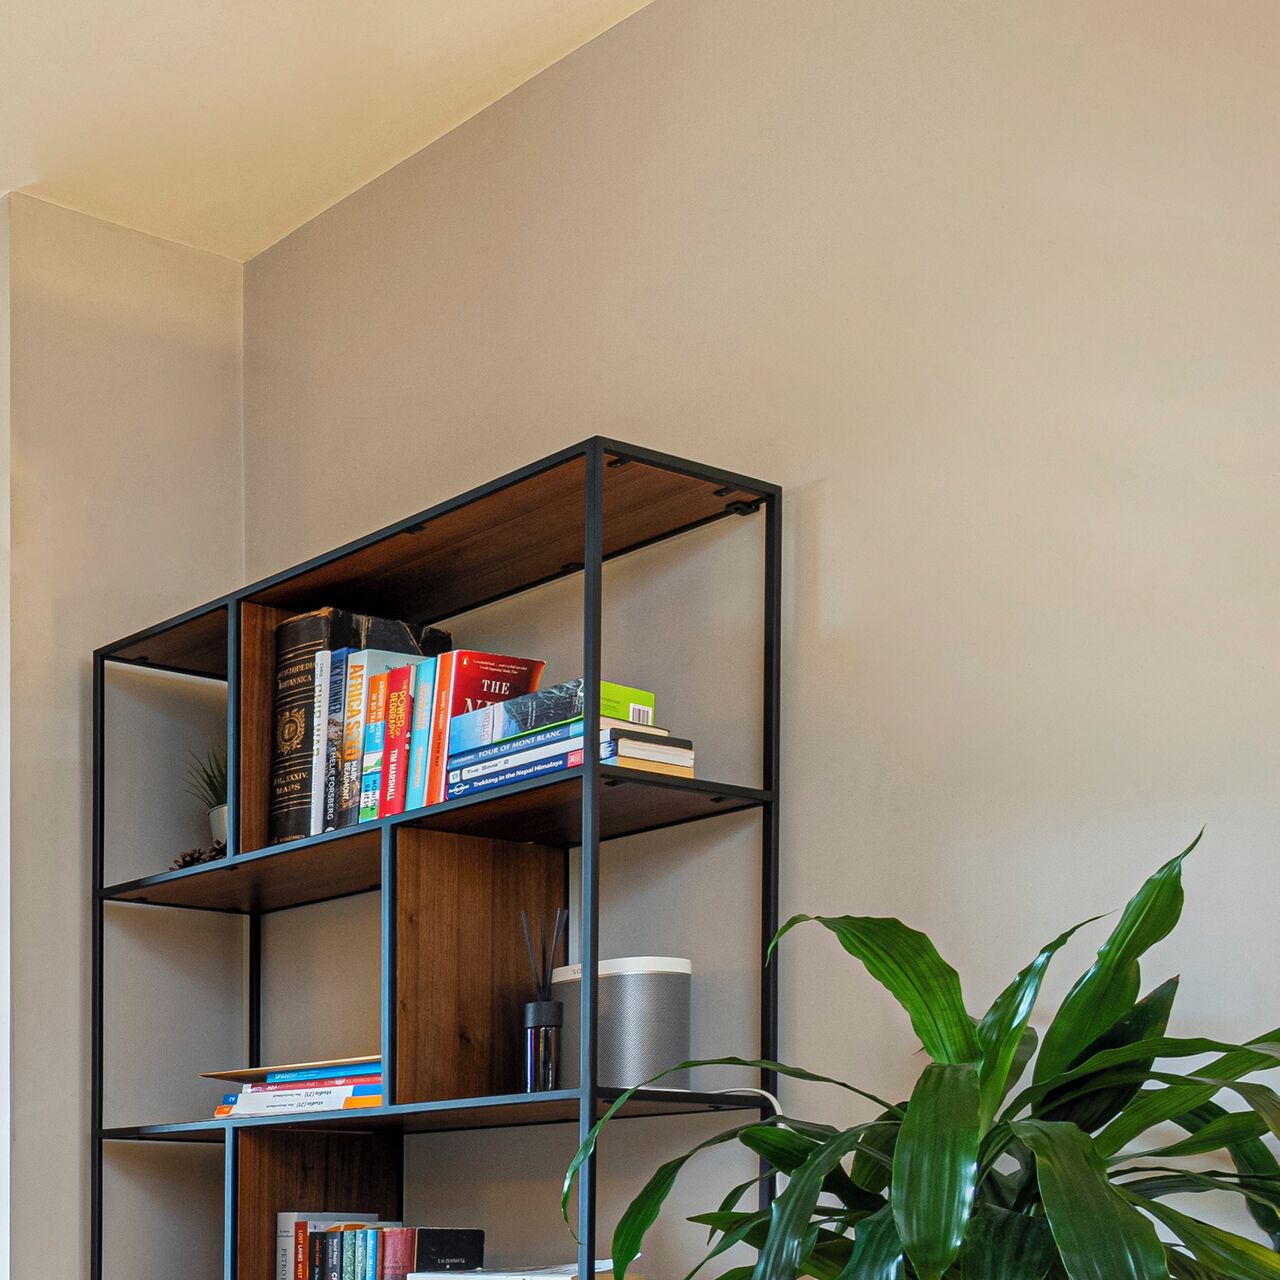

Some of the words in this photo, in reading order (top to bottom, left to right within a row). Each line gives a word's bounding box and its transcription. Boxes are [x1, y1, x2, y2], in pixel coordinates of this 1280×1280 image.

[328, 679, 343, 716] RUNNER
[347, 664, 364, 720] AFRICA
[482, 679, 510, 695] THE
[388, 692, 398, 740] GEOGRAPHY
[395, 690, 407, 728] POWER
[390, 749, 398, 763] TIM
[478, 747, 499, 757] TOUR
[500, 744, 510, 752] OF
[511, 738, 536, 749] MONT
[536, 730, 563, 742] BLANC
[350, 761, 358, 781] MARK
[386, 763, 397, 802] MARSHALL
[473, 776, 498, 787] Trekking
[505, 771, 516, 779] the
[516, 766, 534, 776] Nepal
[534, 760, 563, 772] Himalaya
[327, 776, 336, 821] FORSBERG
[280, 1248, 288, 1276] PETRO
